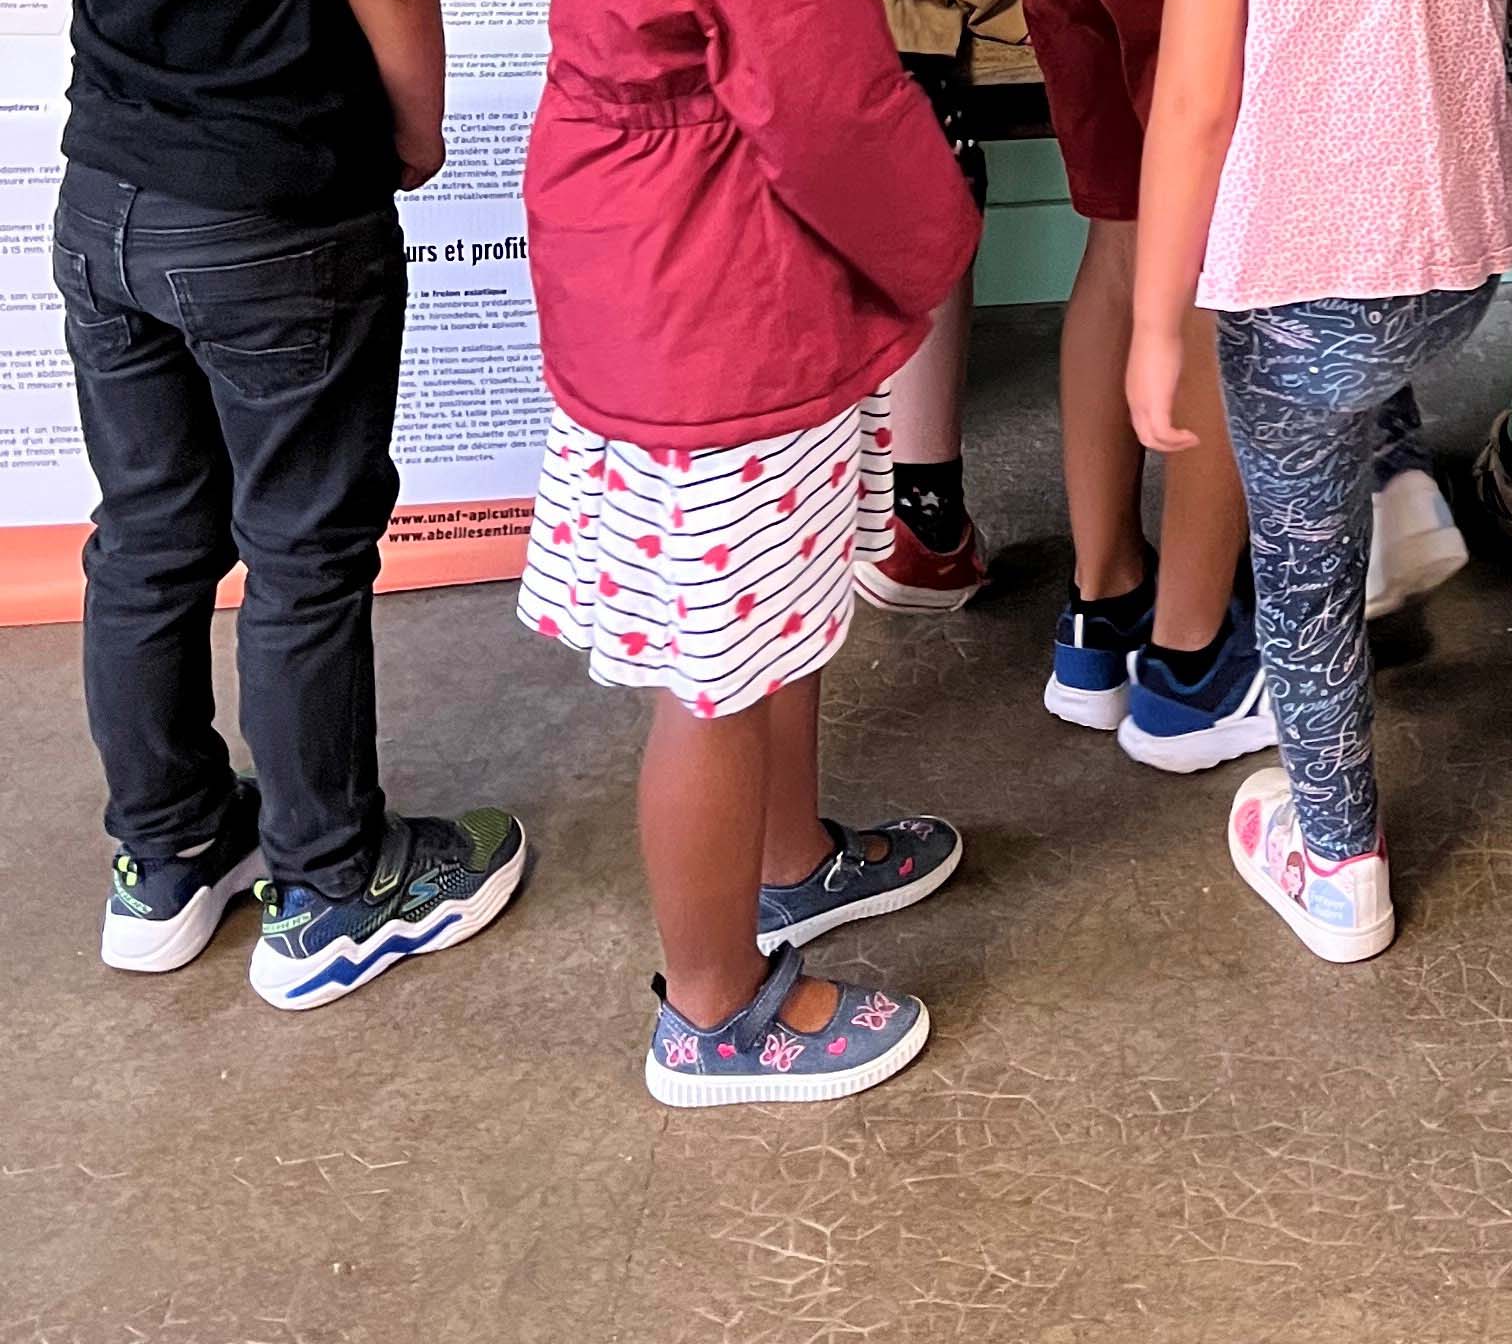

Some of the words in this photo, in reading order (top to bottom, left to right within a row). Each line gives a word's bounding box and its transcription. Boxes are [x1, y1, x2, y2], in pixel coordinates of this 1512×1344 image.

[406, 244, 438, 262] urs
[445, 239, 464, 261] et
[472, 236, 527, 266] profit
